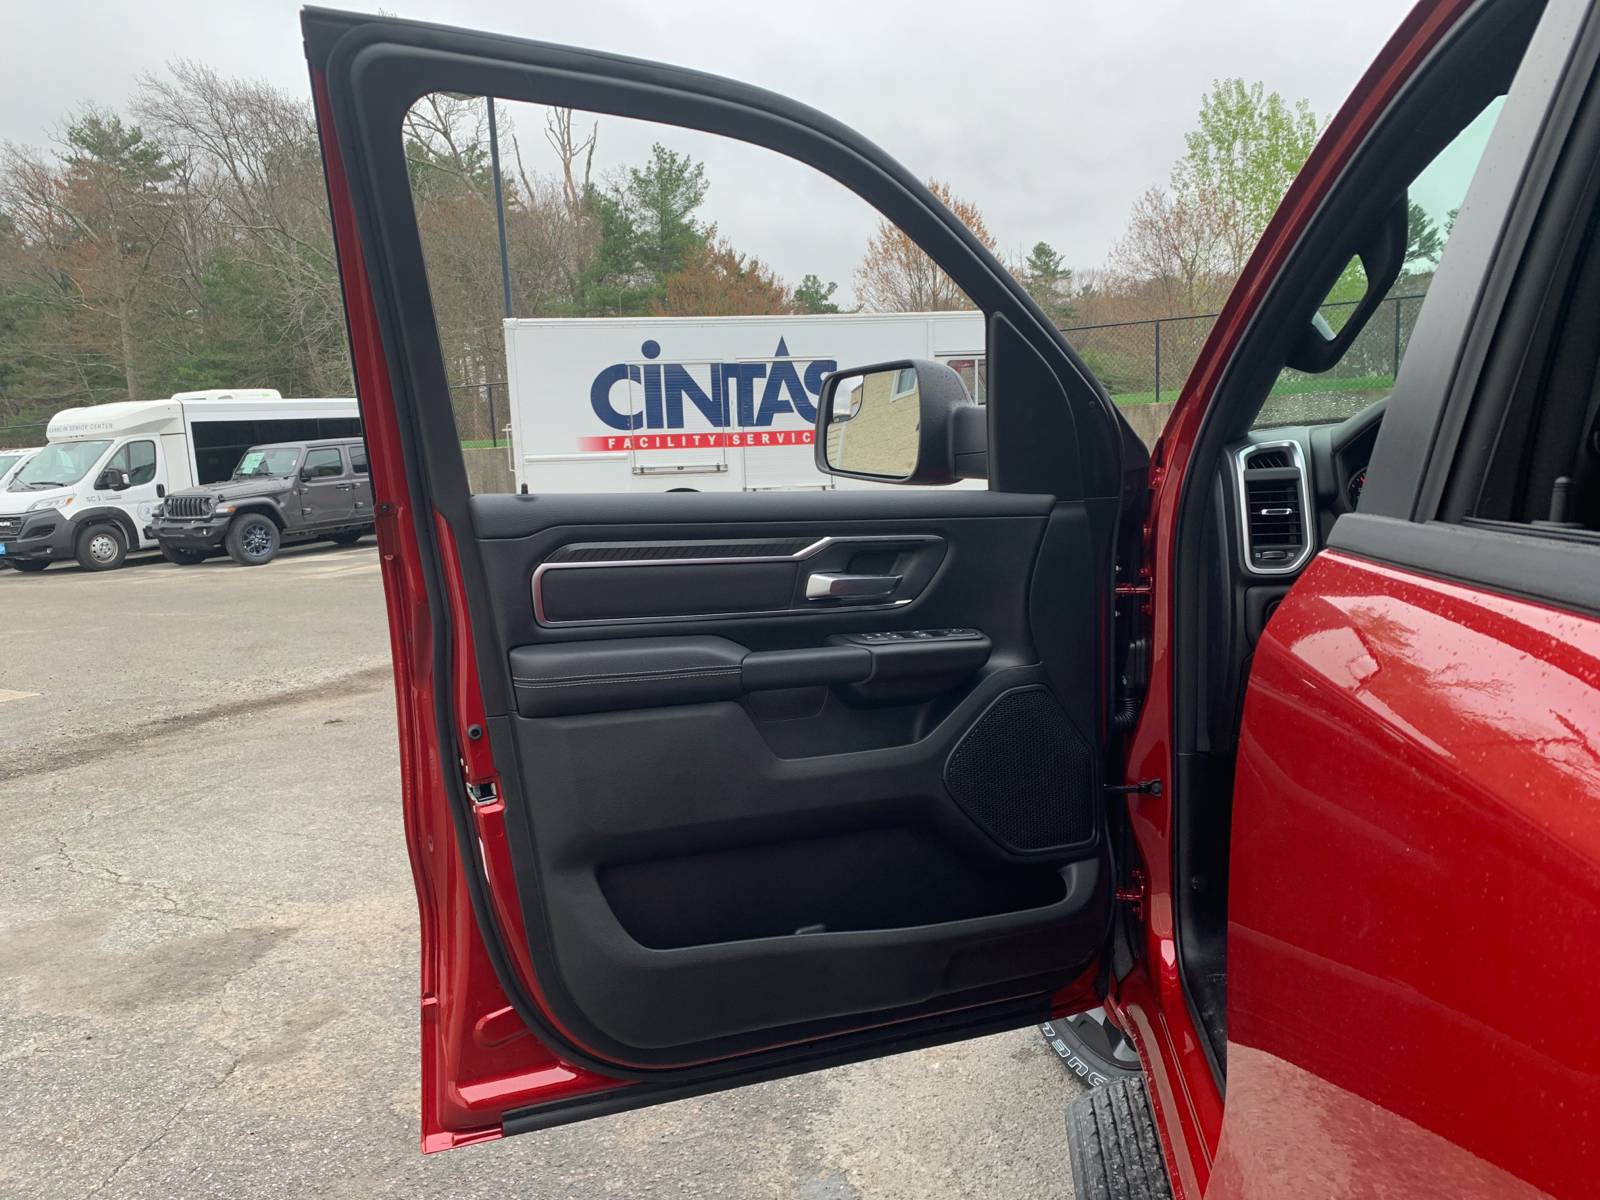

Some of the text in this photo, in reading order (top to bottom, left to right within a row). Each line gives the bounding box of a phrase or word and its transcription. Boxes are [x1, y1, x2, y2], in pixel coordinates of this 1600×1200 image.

[90, 422, 113, 430] CENTER
[608, 432, 812, 449] FACILITY SERVIC
[1042, 1022, 1108, 1087] DUEL
